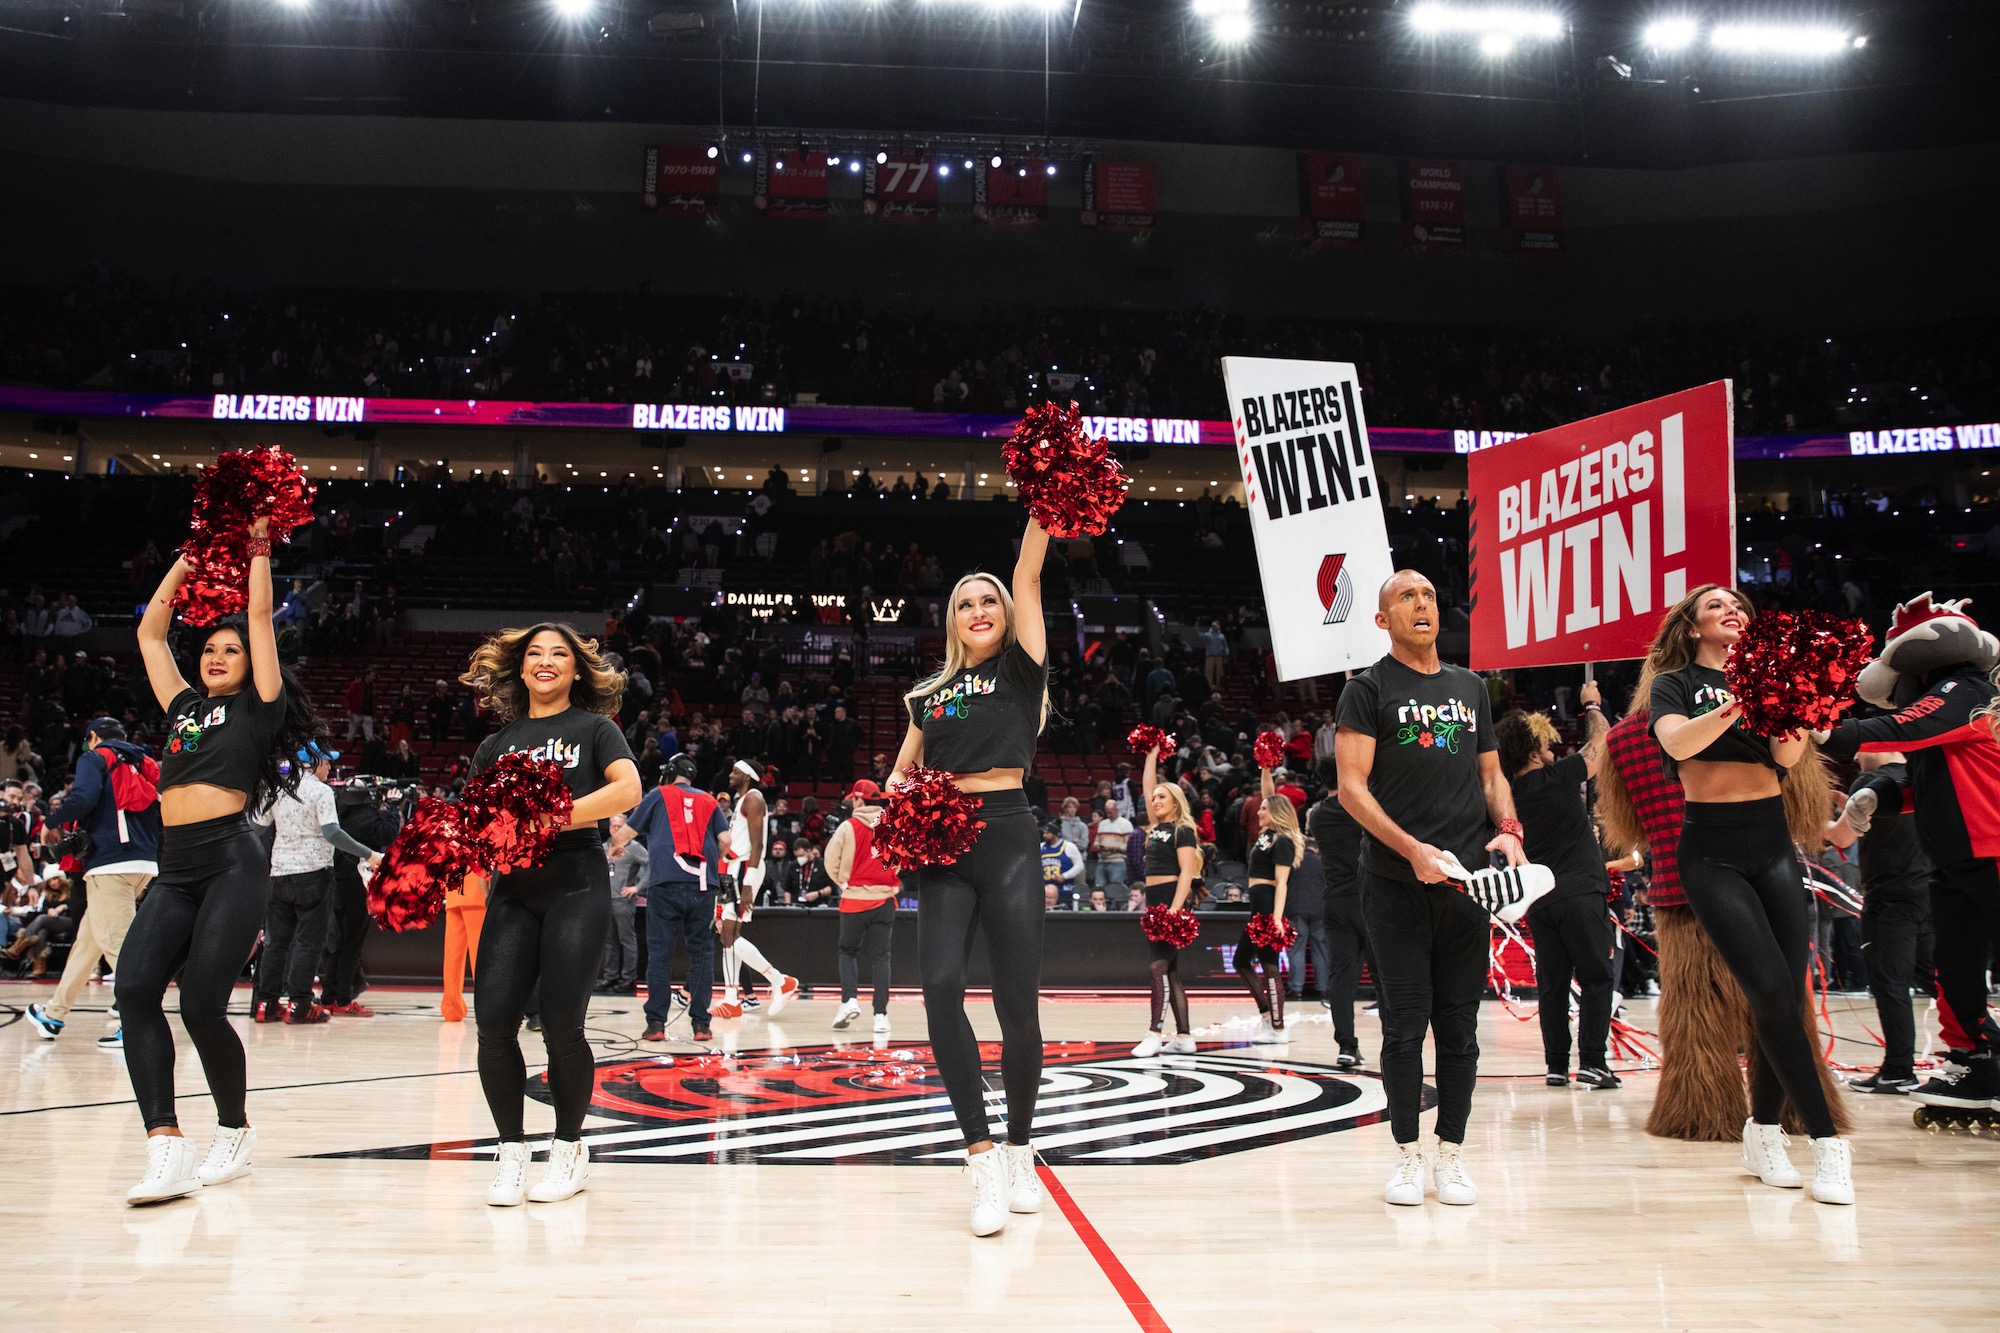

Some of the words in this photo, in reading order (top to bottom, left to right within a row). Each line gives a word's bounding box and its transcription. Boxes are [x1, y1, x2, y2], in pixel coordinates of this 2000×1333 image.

[663, 165, 717, 176] 1970-1988
[885, 162, 930, 194] 77
[1420, 168, 1451, 178] WORLD
[1410, 179, 1461, 191] CHAMPIONS
[213, 394, 311, 421] BLAZERS
[315, 396, 365, 422] WIN
[633, 403, 731, 431] BLAZERS
[735, 406, 785, 432] WIN
[1242, 385, 1342, 437] BLAZERS
[1081, 416, 1148, 443] AZERS
[1151, 418, 1200, 444] WIN
[1454, 430, 1529, 454] BLAZE
[1849, 426, 1953, 455] BLAZERS
[1499, 430, 1655, 543] BLAZERS
[810, 594, 846, 607] RUCK
[1398, 697, 1477, 733] ripcity
[1043, 865, 1061, 880] 33
